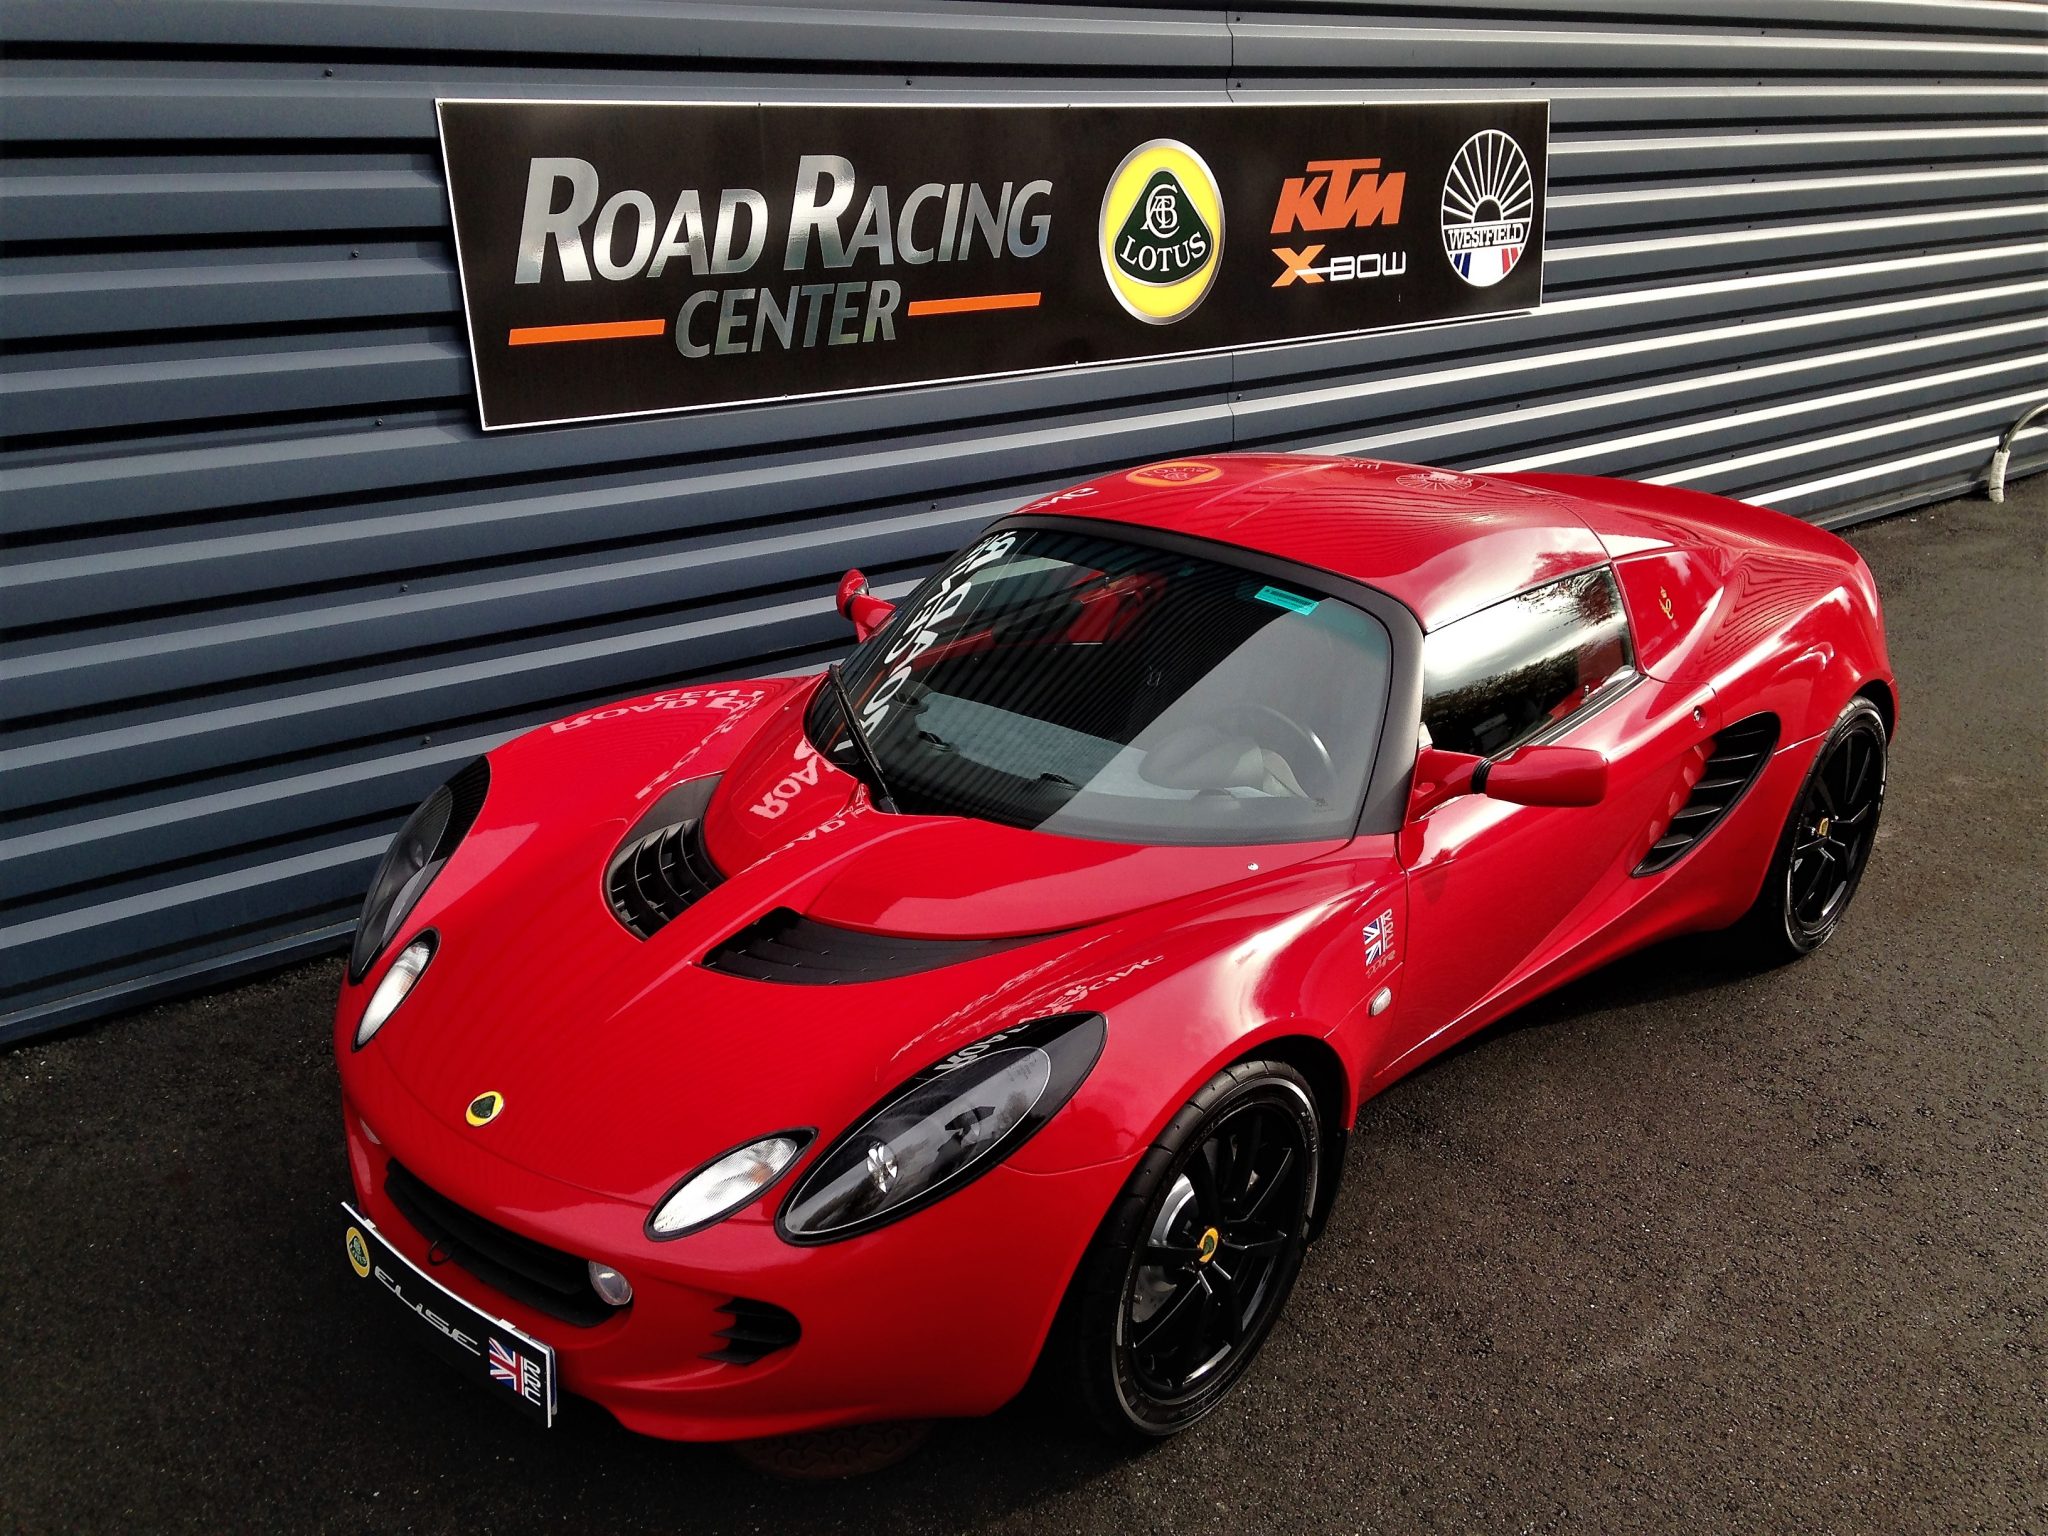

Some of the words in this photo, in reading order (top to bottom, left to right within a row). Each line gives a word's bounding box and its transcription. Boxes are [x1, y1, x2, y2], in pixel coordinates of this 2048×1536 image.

[514, 157, 769, 285] ROAD
[784, 154, 1053, 272] RACING
[1270, 158, 1406, 234] KTM
[1119, 231, 1207, 272] LOTUS
[1448, 223, 1525, 250] WESTFIELD
[674, 279, 902, 358] CENTER
[374, 1265, 481, 1356] ELISE
